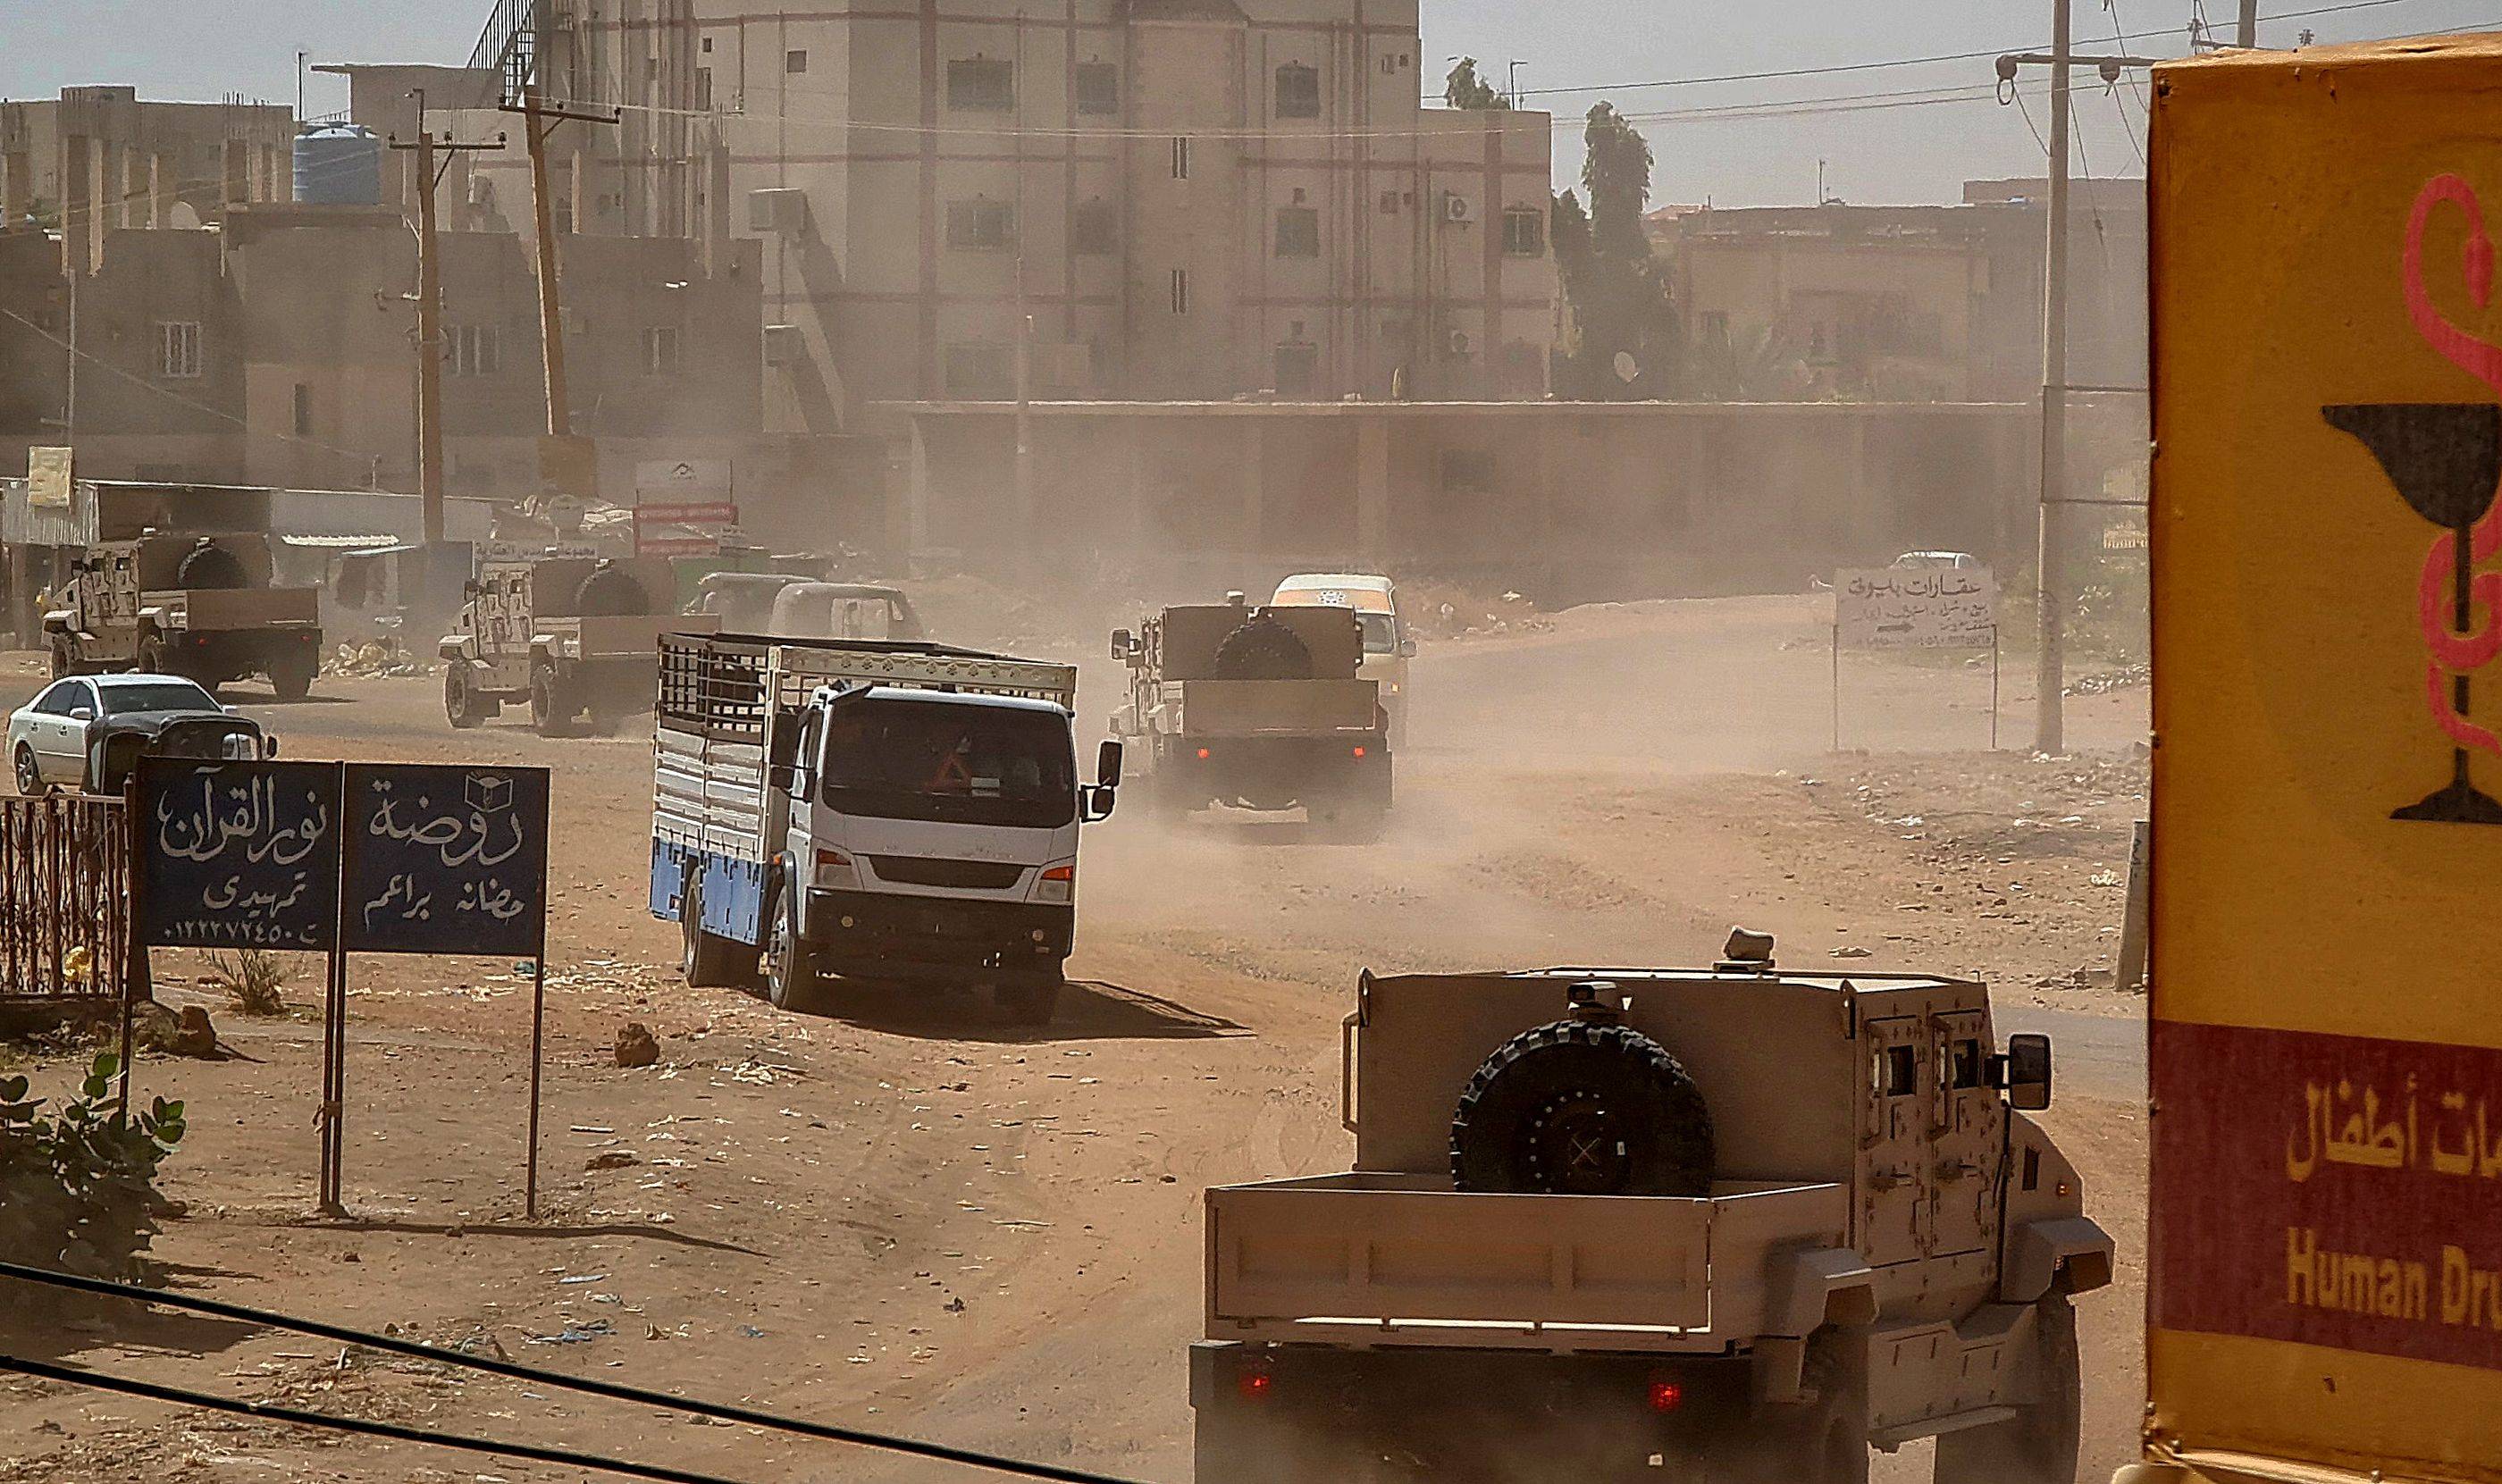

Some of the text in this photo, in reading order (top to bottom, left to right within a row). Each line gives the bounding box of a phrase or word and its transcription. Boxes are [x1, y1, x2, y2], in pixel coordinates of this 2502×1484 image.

[1904, 574, 1982, 599] عقارات
[157, 766, 523, 868] روضة نور القرآن
[364, 872, 432, 934] براعم
[2286, 1071, 2417, 1183] أطفال
[2287, 1226, 2428, 1322] Human
